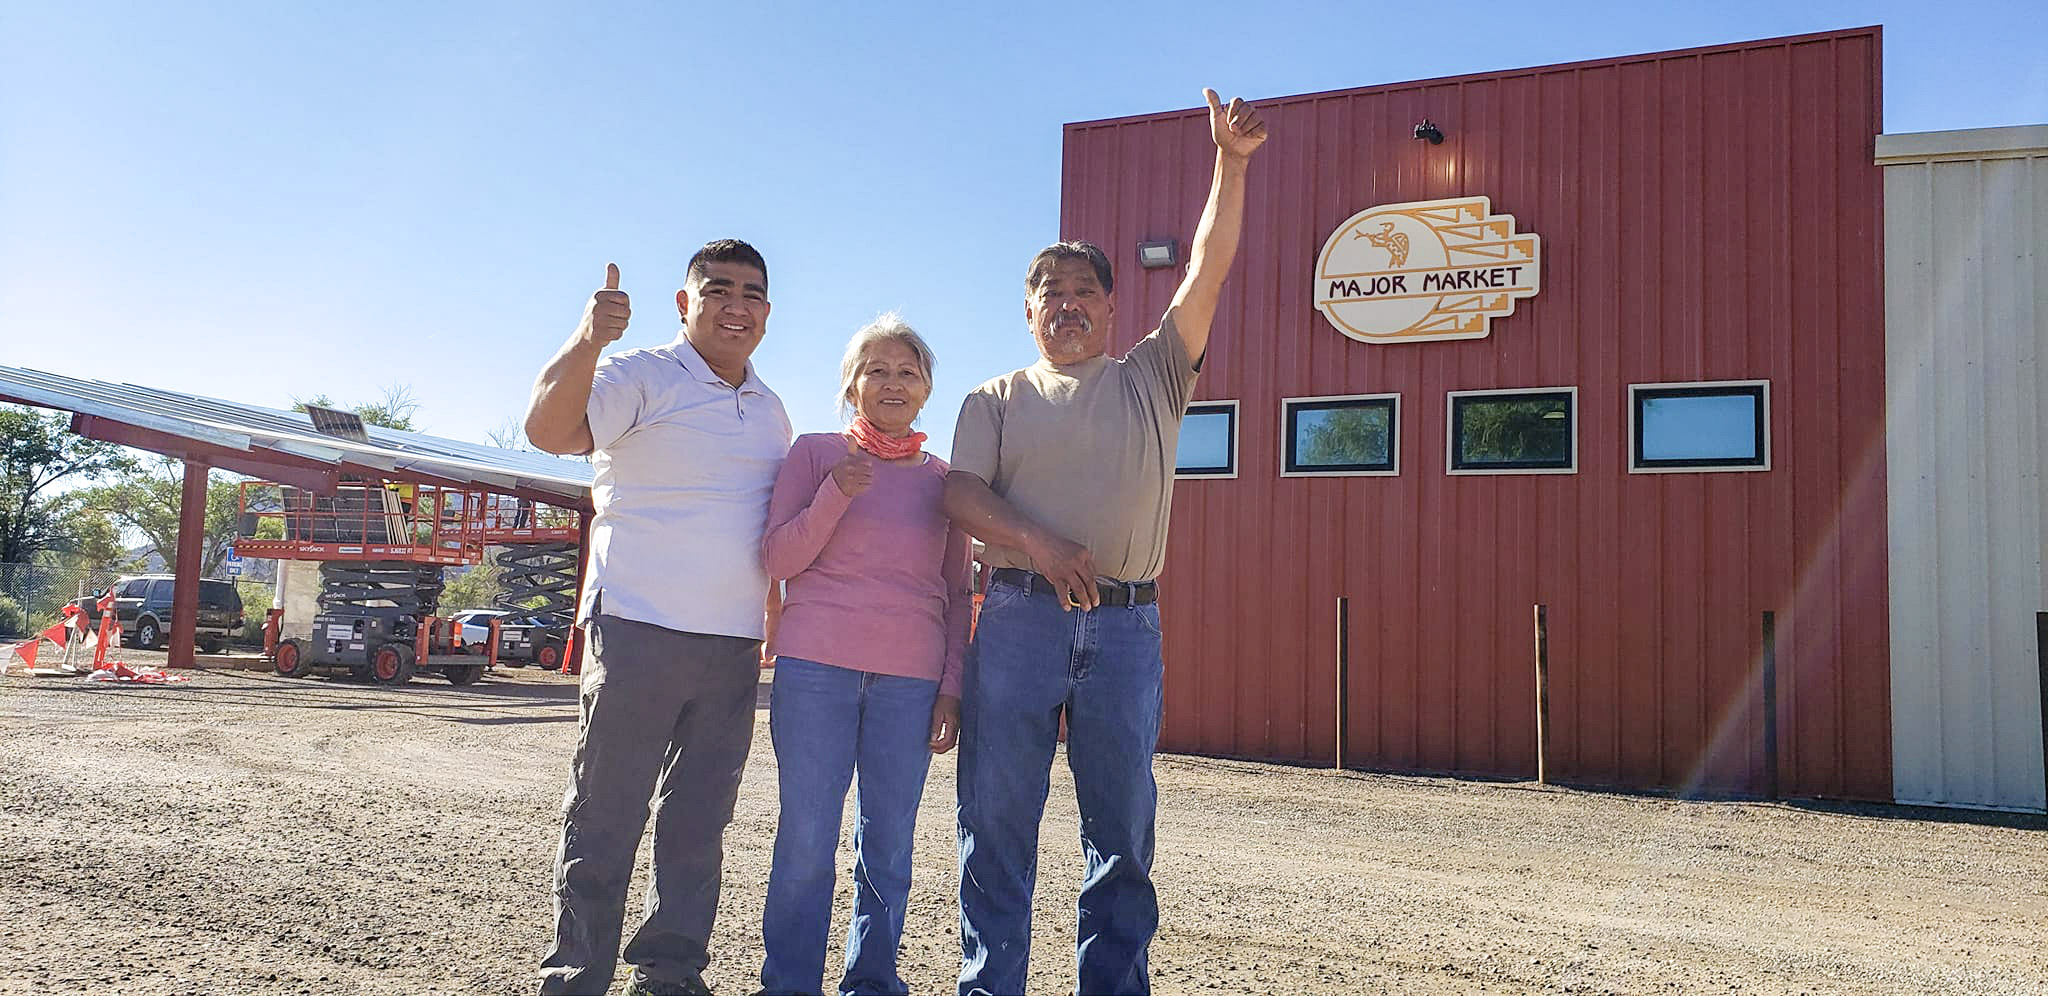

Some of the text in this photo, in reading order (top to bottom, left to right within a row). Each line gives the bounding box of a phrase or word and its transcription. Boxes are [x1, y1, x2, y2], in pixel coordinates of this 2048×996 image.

[1329, 266, 1522, 298] MAJOR MARKET
[299, 544, 326, 553] SKYJACK
